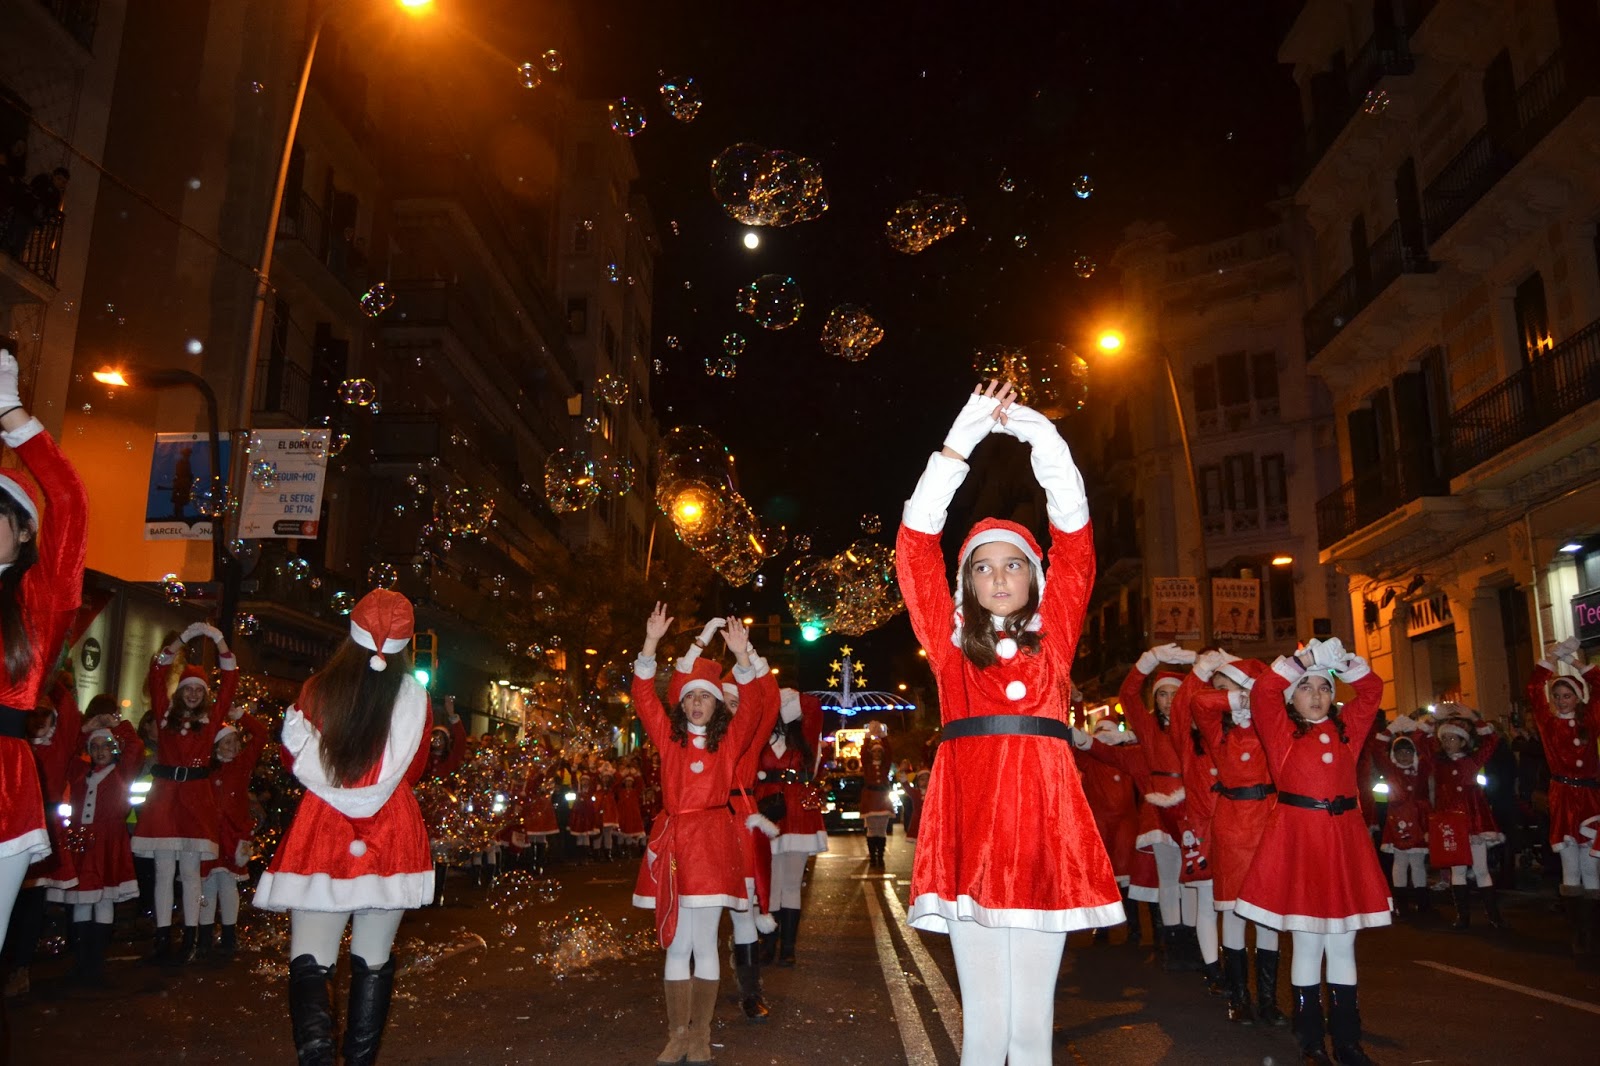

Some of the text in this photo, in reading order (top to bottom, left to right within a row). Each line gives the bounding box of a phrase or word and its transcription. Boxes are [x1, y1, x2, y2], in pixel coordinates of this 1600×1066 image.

[278, 441, 287, 449] EL
[288, 441, 310, 450] BORN
[280, 494, 315, 503] EL SETGE
[284, 504, 314, 514] DE 1714
